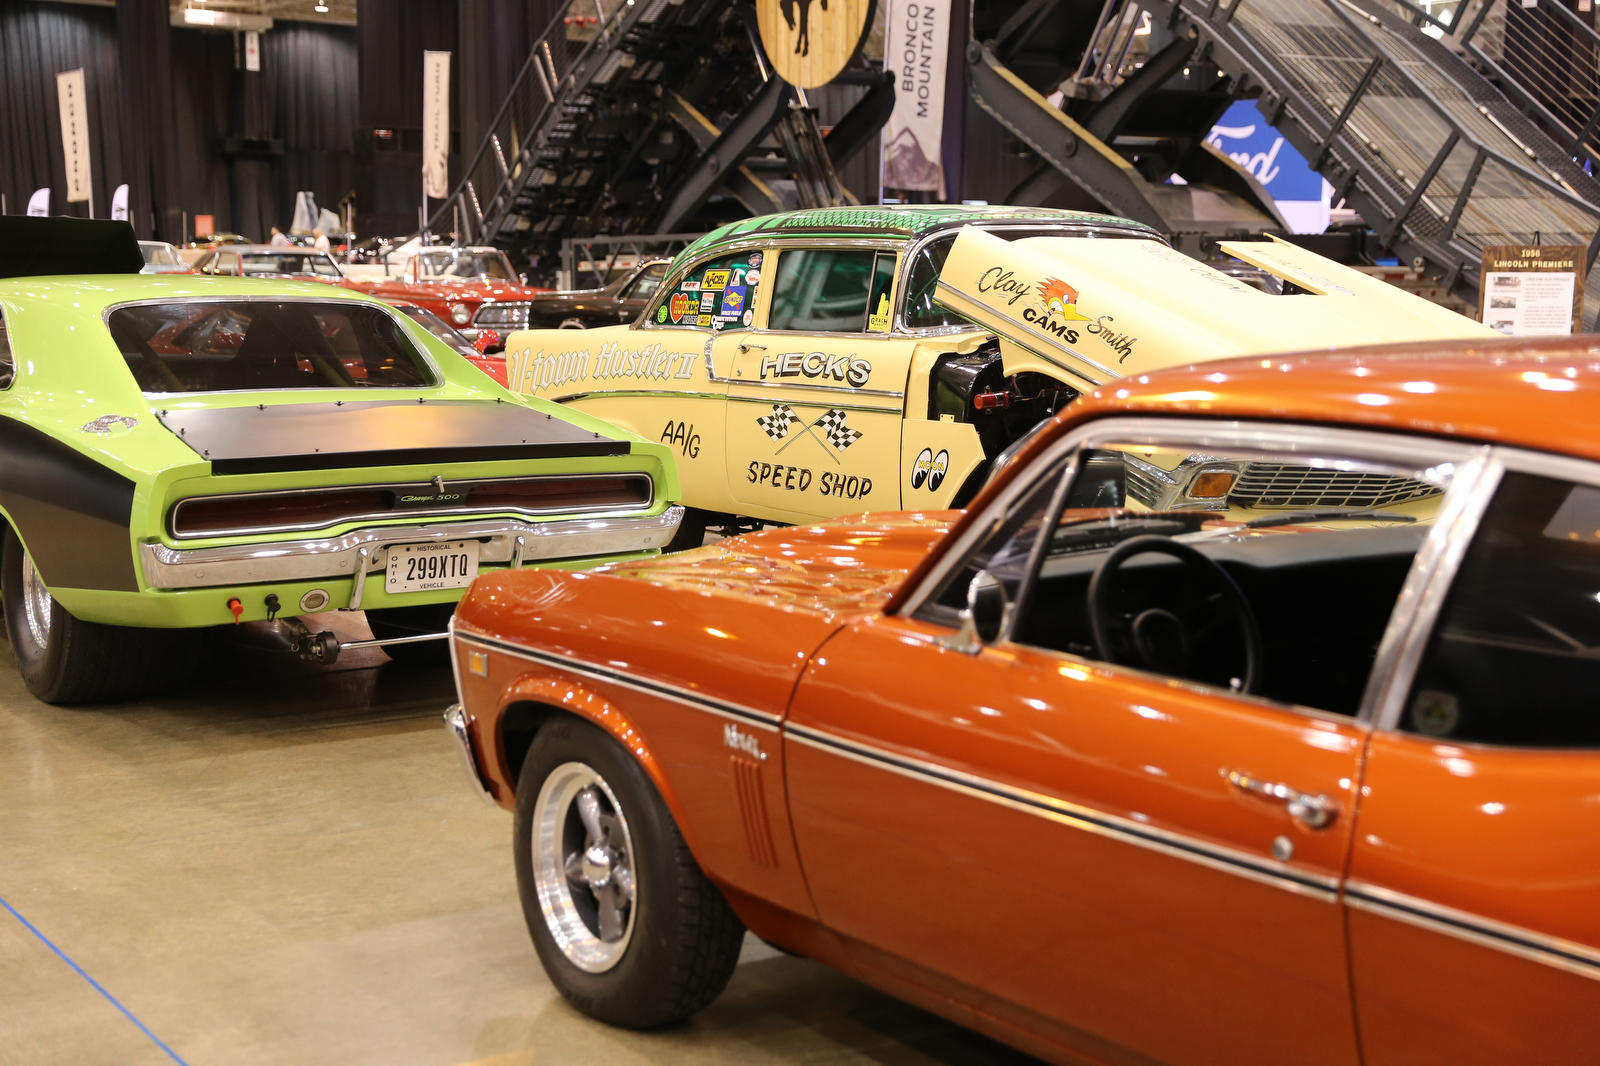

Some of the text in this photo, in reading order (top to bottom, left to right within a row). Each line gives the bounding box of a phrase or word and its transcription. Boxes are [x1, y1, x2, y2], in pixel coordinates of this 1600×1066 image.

[902, 3, 919, 92] BRONCO
[917, 6, 935, 118] MOUNTAIN
[1206, 123, 1284, 185] Frd
[1494, 260, 1574, 268] LINCOLN PREMIERE
[1521, 249, 1541, 258] 1956
[673, 300, 700, 315] HOOKER
[978, 266, 1138, 365] Clay Smith
[1022, 308, 1080, 345] CAMS
[592, 341, 679, 381] Hustler
[673, 353, 699, 379] II
[760, 352, 872, 388] HECK'S
[661, 420, 701, 459] AA/G
[744, 460, 872, 500] SPEED SHOP
[918, 460, 944, 471] MOON
[416, 544, 451, 552] HISTORICAL
[389, 555, 399, 584] OHIO
[406, 553, 468, 581] 299XTQ
